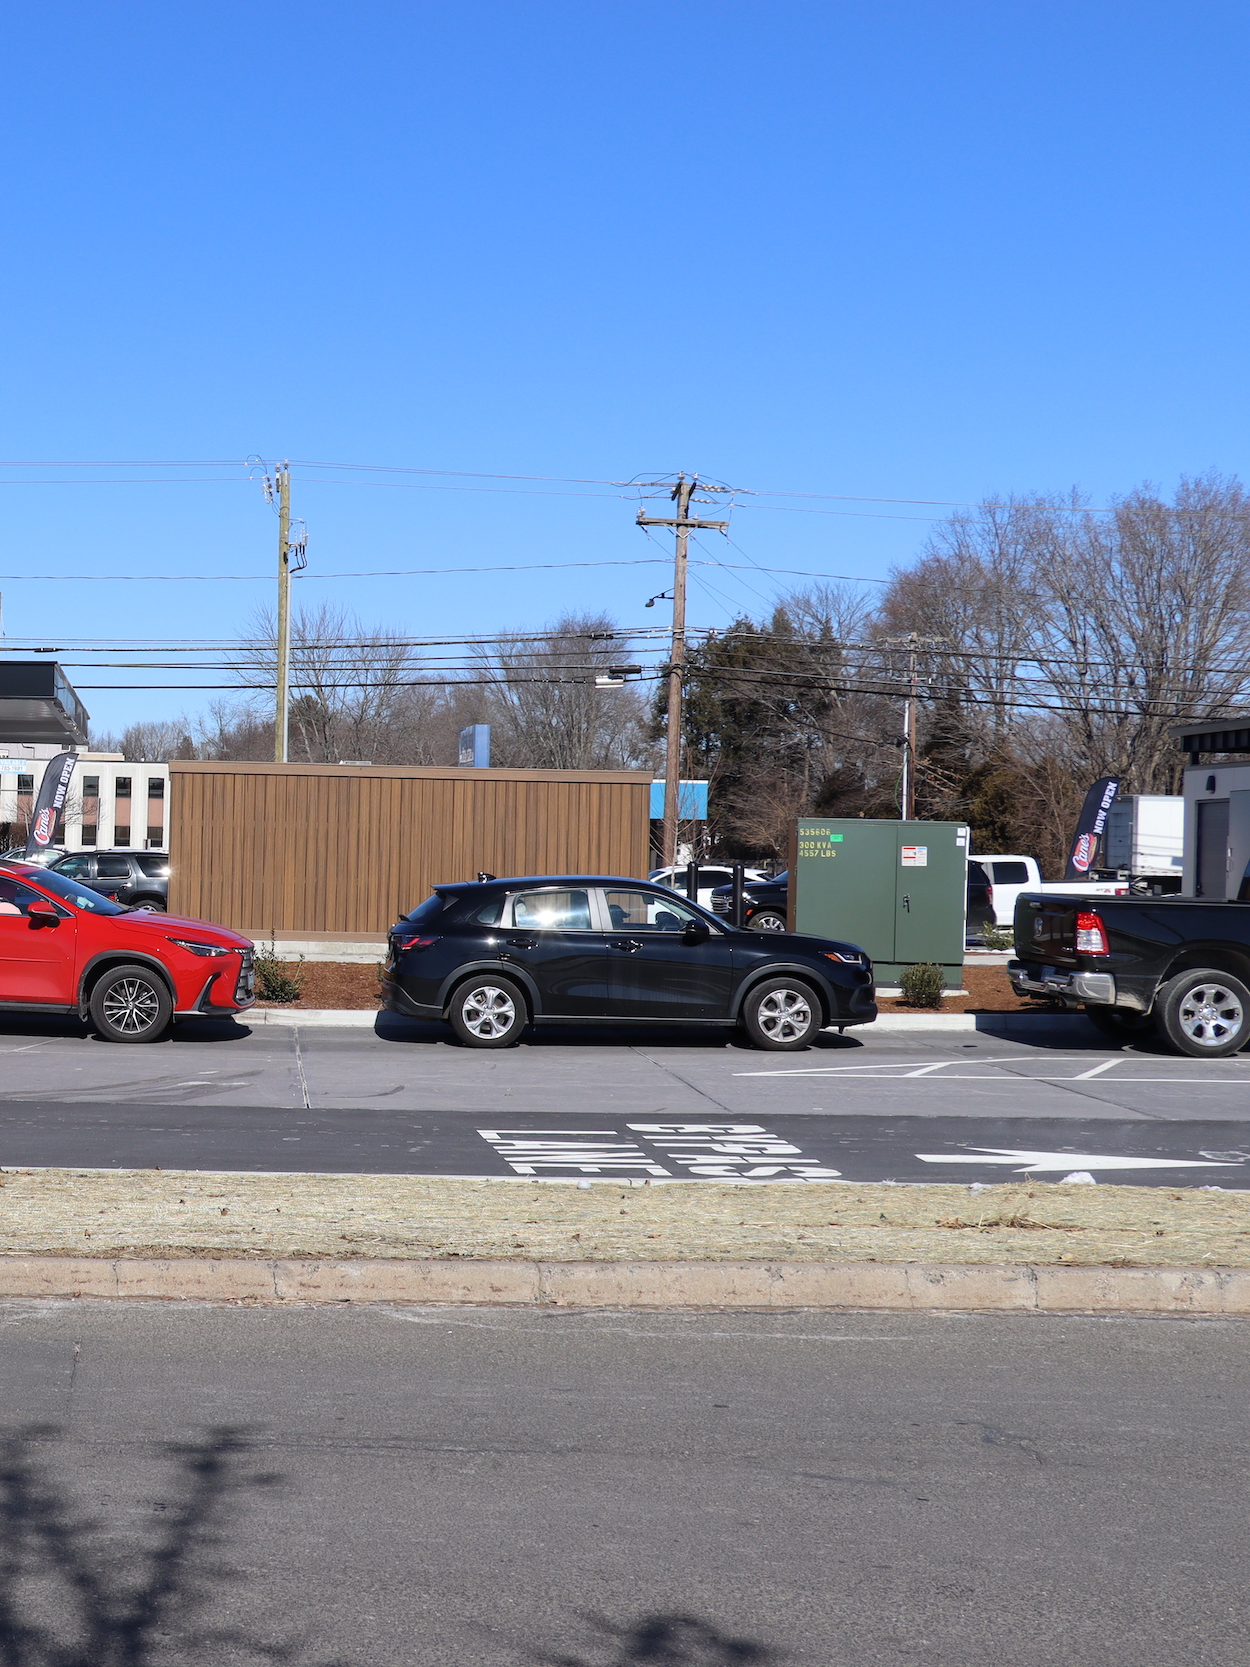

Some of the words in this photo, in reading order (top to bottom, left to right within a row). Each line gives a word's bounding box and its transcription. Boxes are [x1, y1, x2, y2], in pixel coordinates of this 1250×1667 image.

[53, 784, 67, 809] NOW
[60, 757, 75, 784] OPEN
[34, 808, 50, 844] Cane's
[1093, 809, 1107, 835] NOW
[1101, 781, 1118, 809] OPEN
[799, 841, 815, 849] 300
[816, 841, 832, 849] KVA
[799, 849, 819, 857] 4557
[820, 849, 837, 858] LBS
[1072, 833, 1090, 872] Cane's
[476, 1129, 674, 1175] LANE
[626, 1123, 853, 1182] BYPAS
